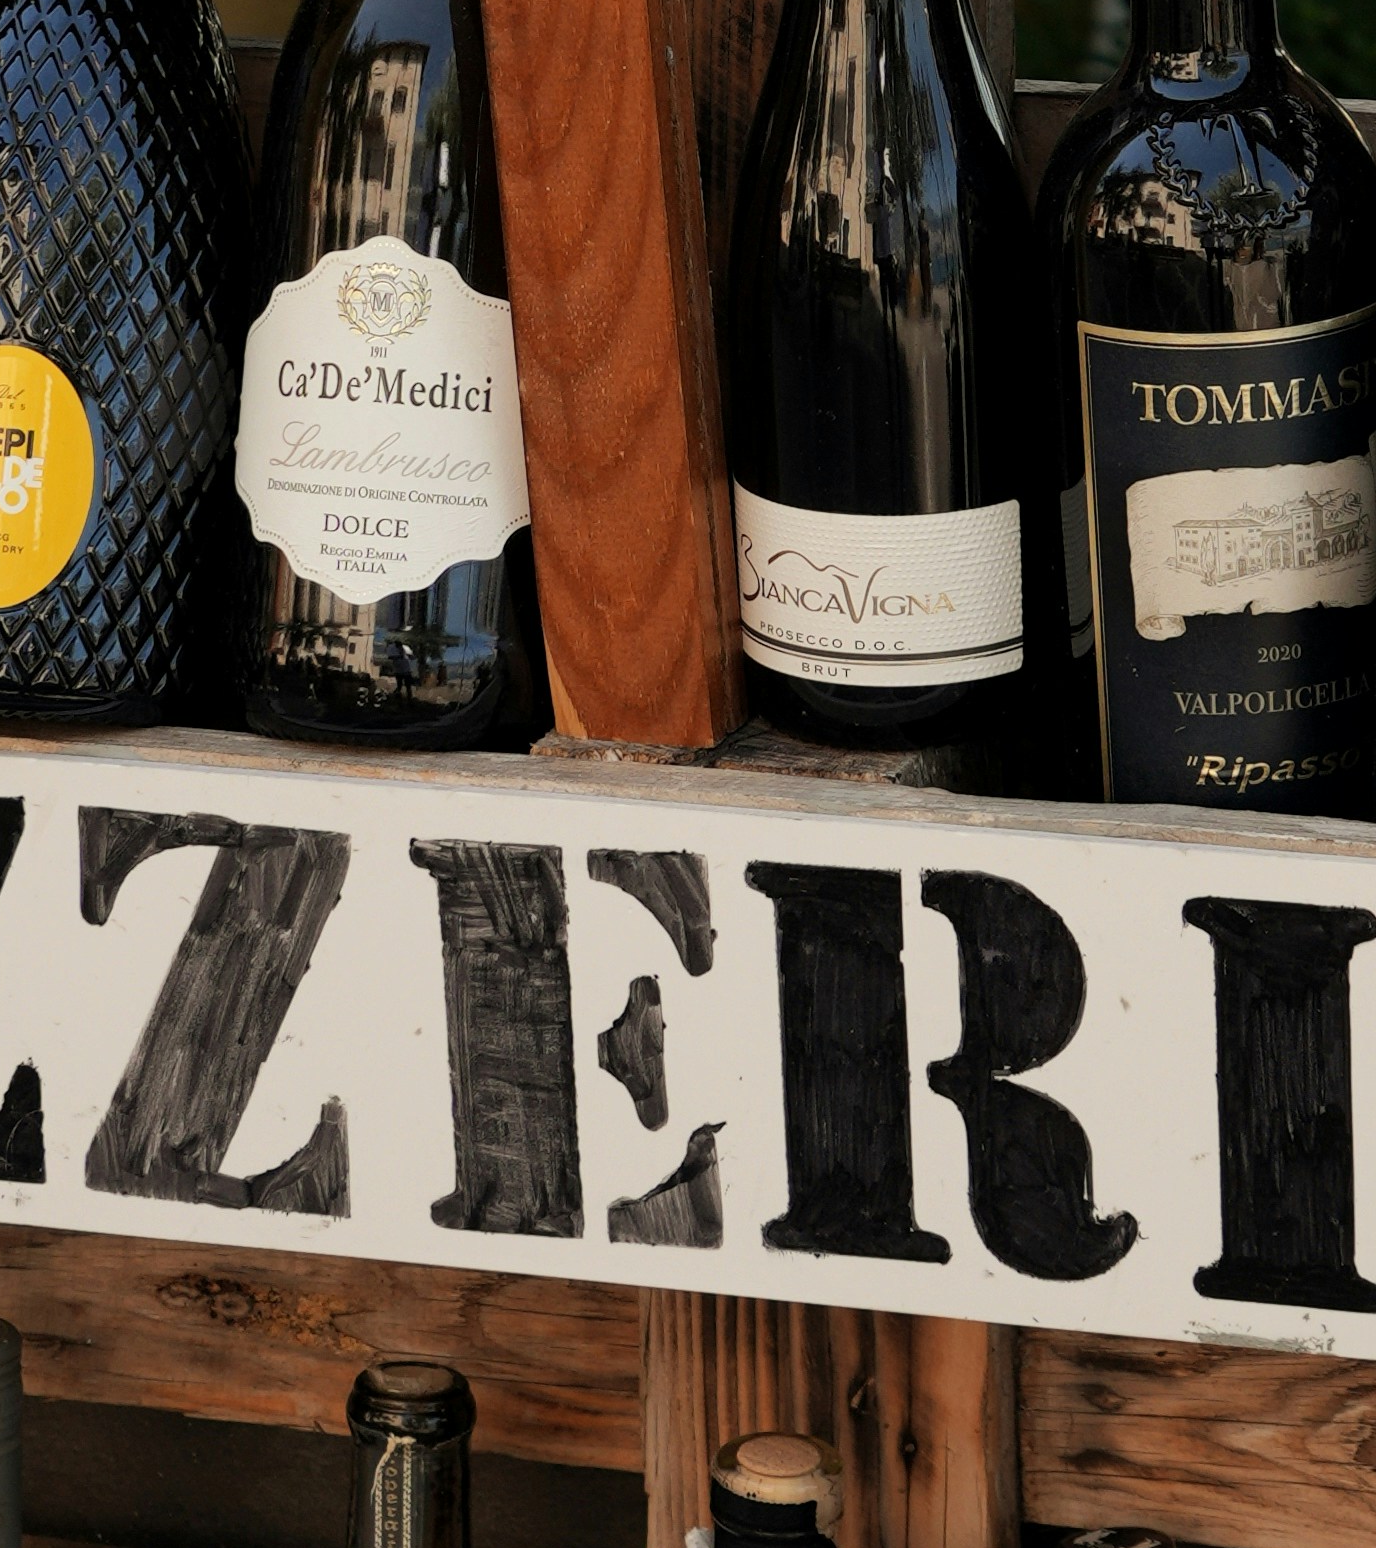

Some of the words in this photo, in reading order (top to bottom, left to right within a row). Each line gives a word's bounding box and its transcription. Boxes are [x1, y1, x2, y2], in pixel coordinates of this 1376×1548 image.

[369, 345, 389, 360] 1911
[269, 421, 494, 484] Lambrusco
[266, 477, 343, 497] DENOMINAZIONE
[357, 485, 407, 502] ORIGINE
[408, 489, 489, 508] CONTROLLATA
[322, 513, 411, 539] DOLCE
[2, 544, 25, 555] DRY
[319, 543, 364, 559] REGGIO
[365, 548, 409, 562] EMILIA
[335, 559, 388, 575] ITALIA
[759, 620, 843, 650] PROSECCO
[853, 640, 912, 653] D.O.C.
[1256, 643, 1302, 664] 2020
[800, 661, 852, 680] BRUT
[1172, 672, 1372, 716] VALPOLICELLA
